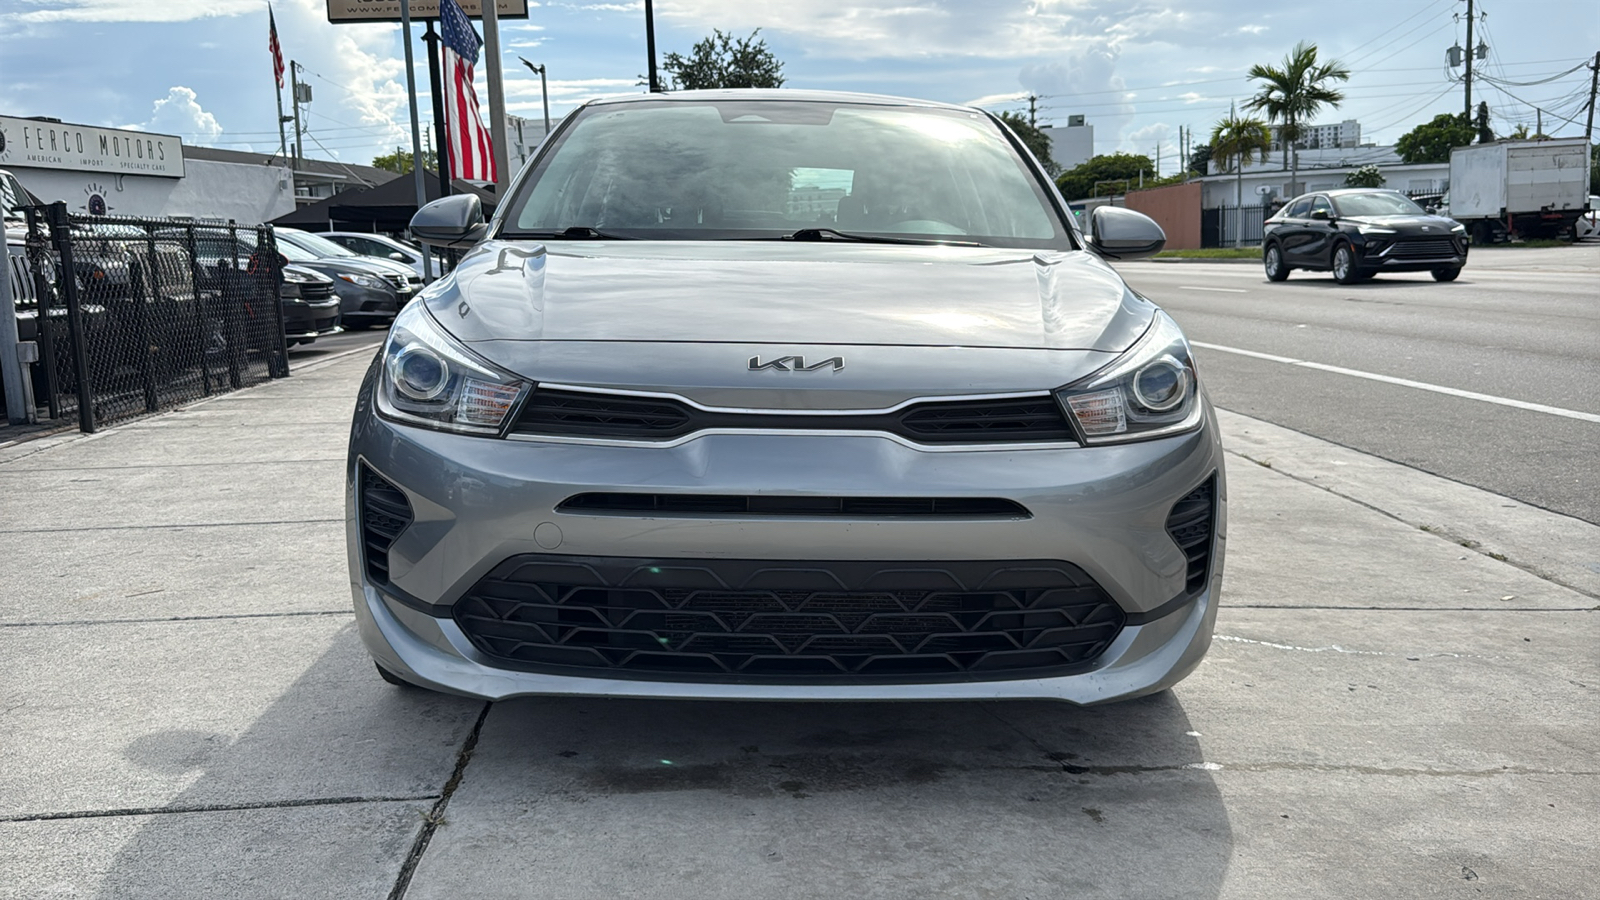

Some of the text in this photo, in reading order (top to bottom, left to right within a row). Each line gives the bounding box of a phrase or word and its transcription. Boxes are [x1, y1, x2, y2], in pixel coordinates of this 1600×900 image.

[347, 4, 508, 13] WWW.FECOMRS.M
[24, 126, 165, 161] FERCO MOTORS
[27, 154, 62, 163] AMERICAN
[80, 159, 104, 167] IMPORT
[120, 161, 150, 170] SPECIALTY
